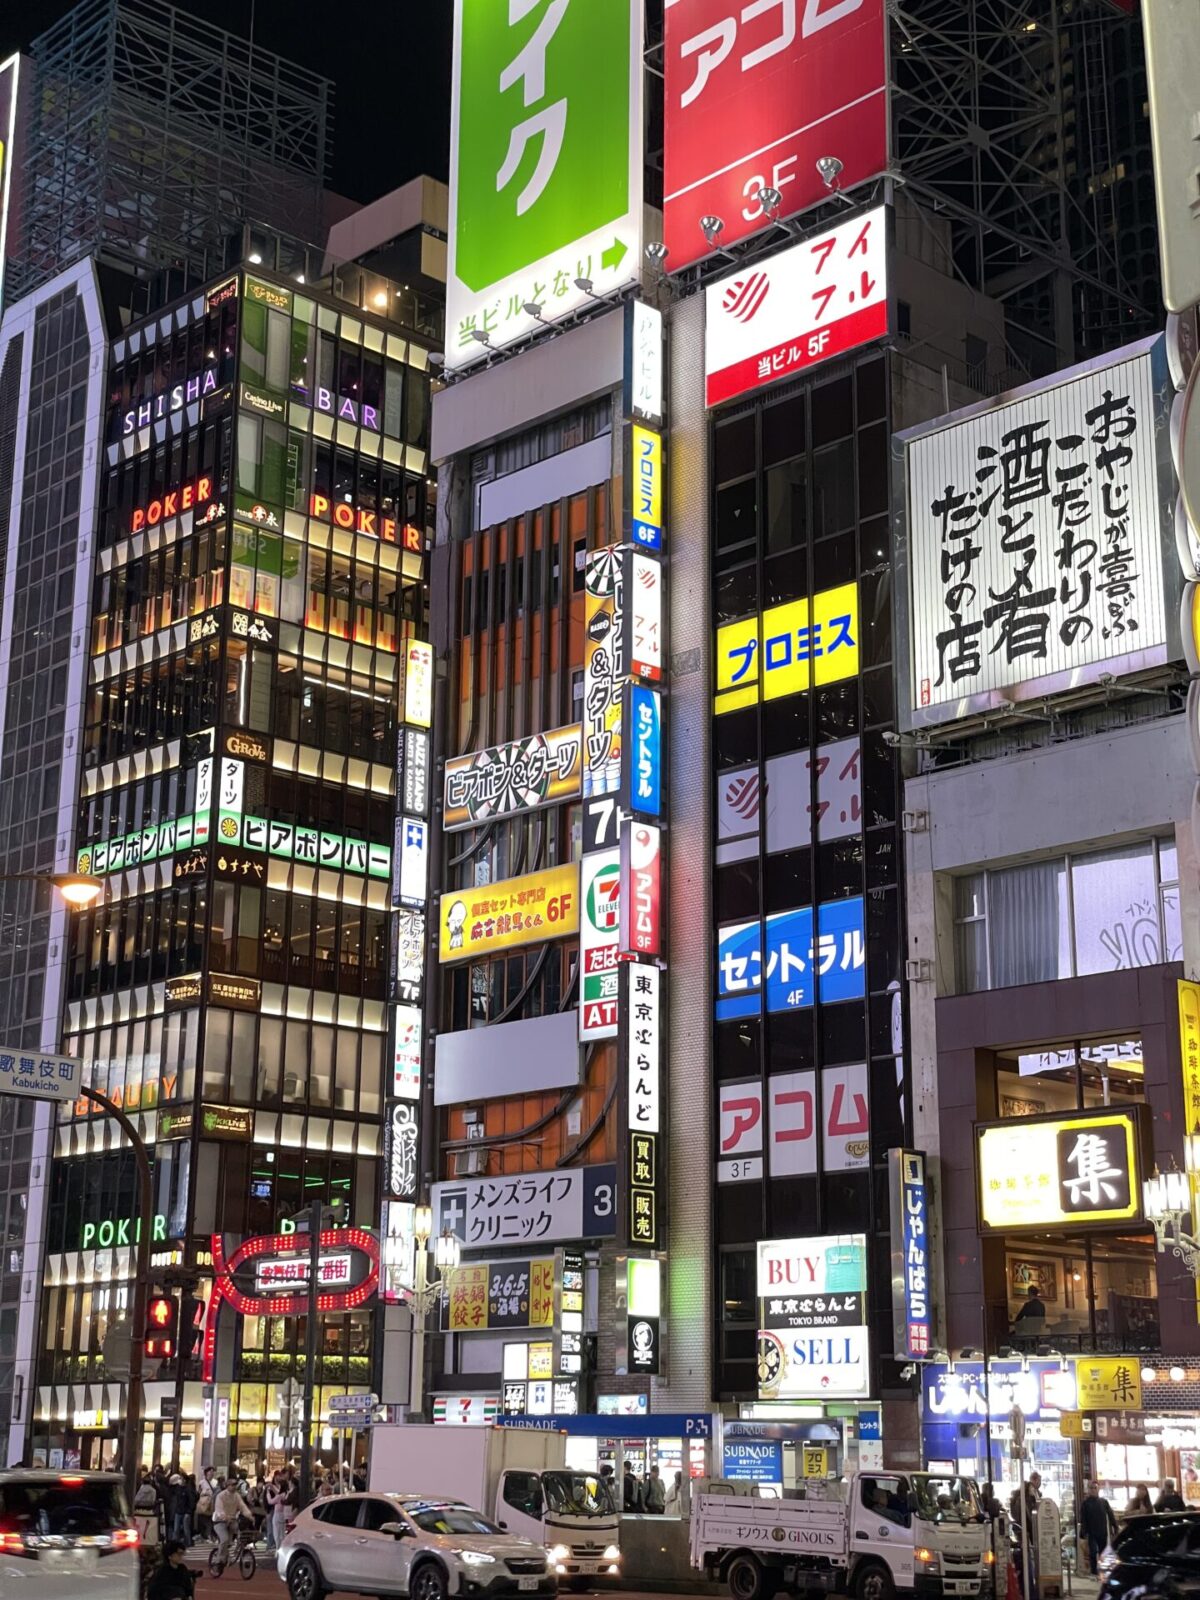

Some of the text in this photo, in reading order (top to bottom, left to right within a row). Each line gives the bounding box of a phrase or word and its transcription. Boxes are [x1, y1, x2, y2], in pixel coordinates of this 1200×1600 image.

[758, 330, 831, 378] 当ビル 5F
[124, 370, 216, 434] SHISHA
[318, 387, 378, 430] BAR
[639, 440, 655, 517] プロミス
[132, 478, 212, 531] POKER
[312, 495, 420, 550] POKER
[638, 525, 655, 544] 6F
[1052, 434, 1097, 647] こだわりの
[931, 485, 983, 686] だけの店
[728, 614, 856, 682] プロミス
[227, 736, 266, 760] GROVE
[638, 701, 653, 799] セントラル
[225, 762, 239, 804] ダーツ
[415, 734, 426, 812] BUZZ STAND
[447, 740, 578, 808] ビアポン&ダーツ
[93, 825, 192, 871] ビアポンバー
[244, 822, 389, 868] ビアポンバー
[547, 893, 572, 922] 6F
[597, 901, 620, 914] ELEVE
[636, 873, 653, 934] アコム
[637, 936, 652, 949] 3F
[720, 930, 864, 991] セントラル
[400, 981, 420, 1000] 7F
[787, 989, 804, 1005] 4F
[587, 1003, 618, 1028] AT
[0, 1054, 75, 1080] 歌舞伎町
[12, 1076, 60, 1092] Kabukicho
[722, 1084, 869, 1151] アコム
[731, 1162, 752, 1178] 3F
[1062, 1133, 1122, 1204] 集
[470, 1176, 573, 1210] メンズライフ
[593, 1184, 617, 1216] 3
[83, 1214, 166, 1248] POKR
[470, 1210, 552, 1243] クリニック
[635, 1196, 651, 1237] 販売
[768, 1257, 820, 1284] BUY
[789, 1316, 838, 1326] TOKYO BRAND
[792, 1338, 860, 1365] SELL
[1110, 1365, 1137, 1402] 集
[686, 1419, 694, 1434] P
[859, 1422, 878, 1430] セントラ
[724, 1445, 775, 1459] SUBNADE
[736, 1526, 769, 1540] ギノウス
